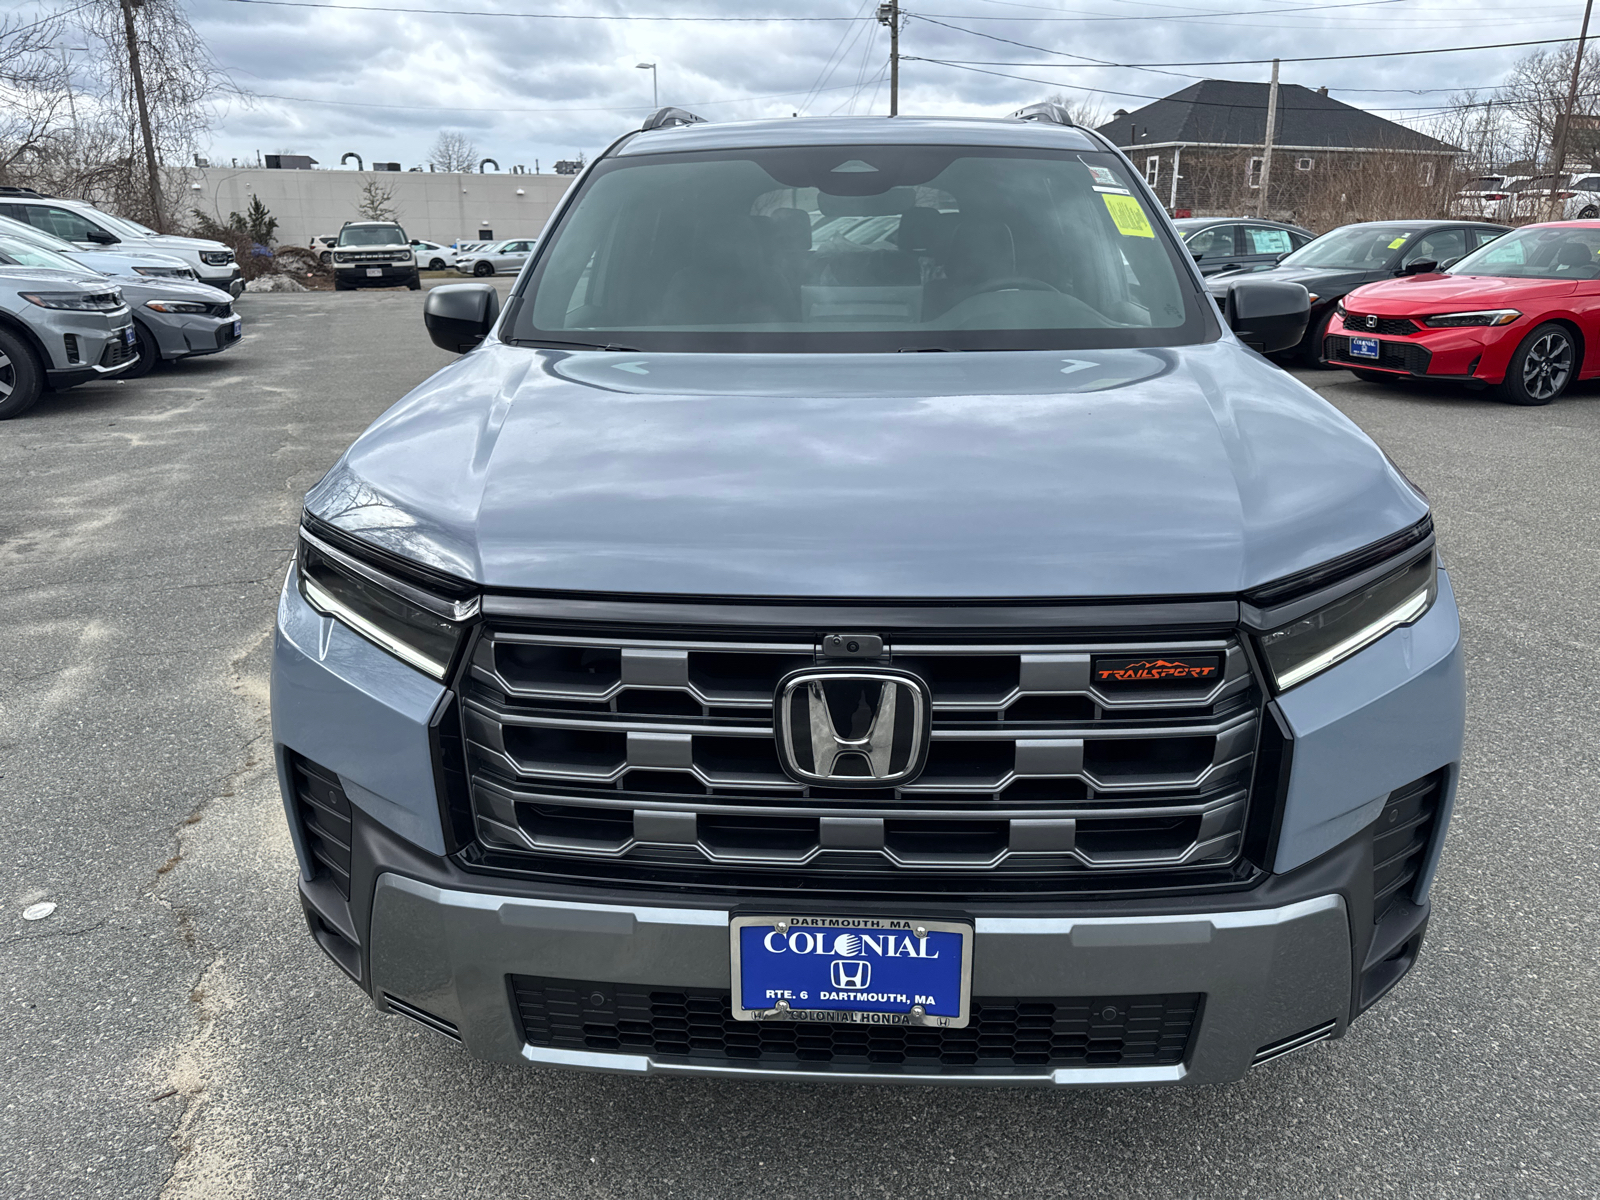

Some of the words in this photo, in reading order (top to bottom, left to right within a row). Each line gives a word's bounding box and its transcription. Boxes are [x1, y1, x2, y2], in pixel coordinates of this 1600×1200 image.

[1098, 667, 1215, 680] TRAILSPORT
[790, 918, 884, 929] DARTMOUTH,
[890, 921, 911, 929] MA
[763, 932, 939, 958] COLONIAL
[766, 990, 797, 999] RTE.
[800, 991, 808, 1000] 6
[820, 991, 911, 1005] DARTMOUTH,
[914, 995, 936, 1006] MA
[790, 1010, 857, 1023] COLONIAL
[861, 1013, 911, 1025] HONDA
